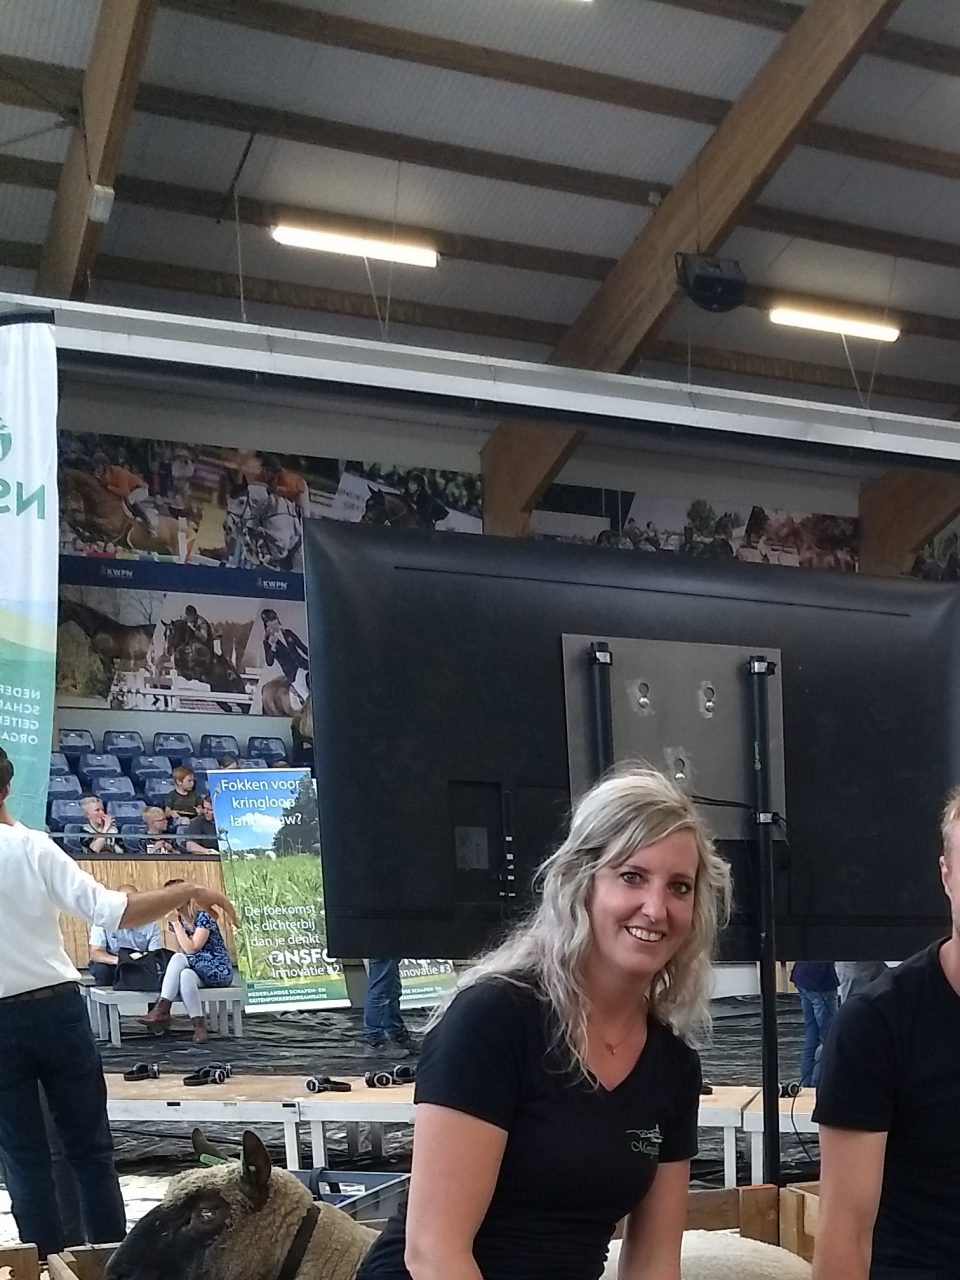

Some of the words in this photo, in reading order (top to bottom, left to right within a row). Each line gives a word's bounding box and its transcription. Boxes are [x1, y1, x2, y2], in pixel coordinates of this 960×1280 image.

[263, 580, 288, 589] KWPN
[220, 779, 269, 791] Fokken
[271, 780, 300, 791] voor
[232, 797, 296, 810] kringloop
[245, 907, 260, 916] De
[263, 904, 316, 916] toekomst
[262, 918, 315, 931] dichterbij
[251, 936, 273, 947] dan
[275, 937, 286, 948] je
[288, 933, 320, 945] denkt
[399, 964, 439, 977] nnovatie
